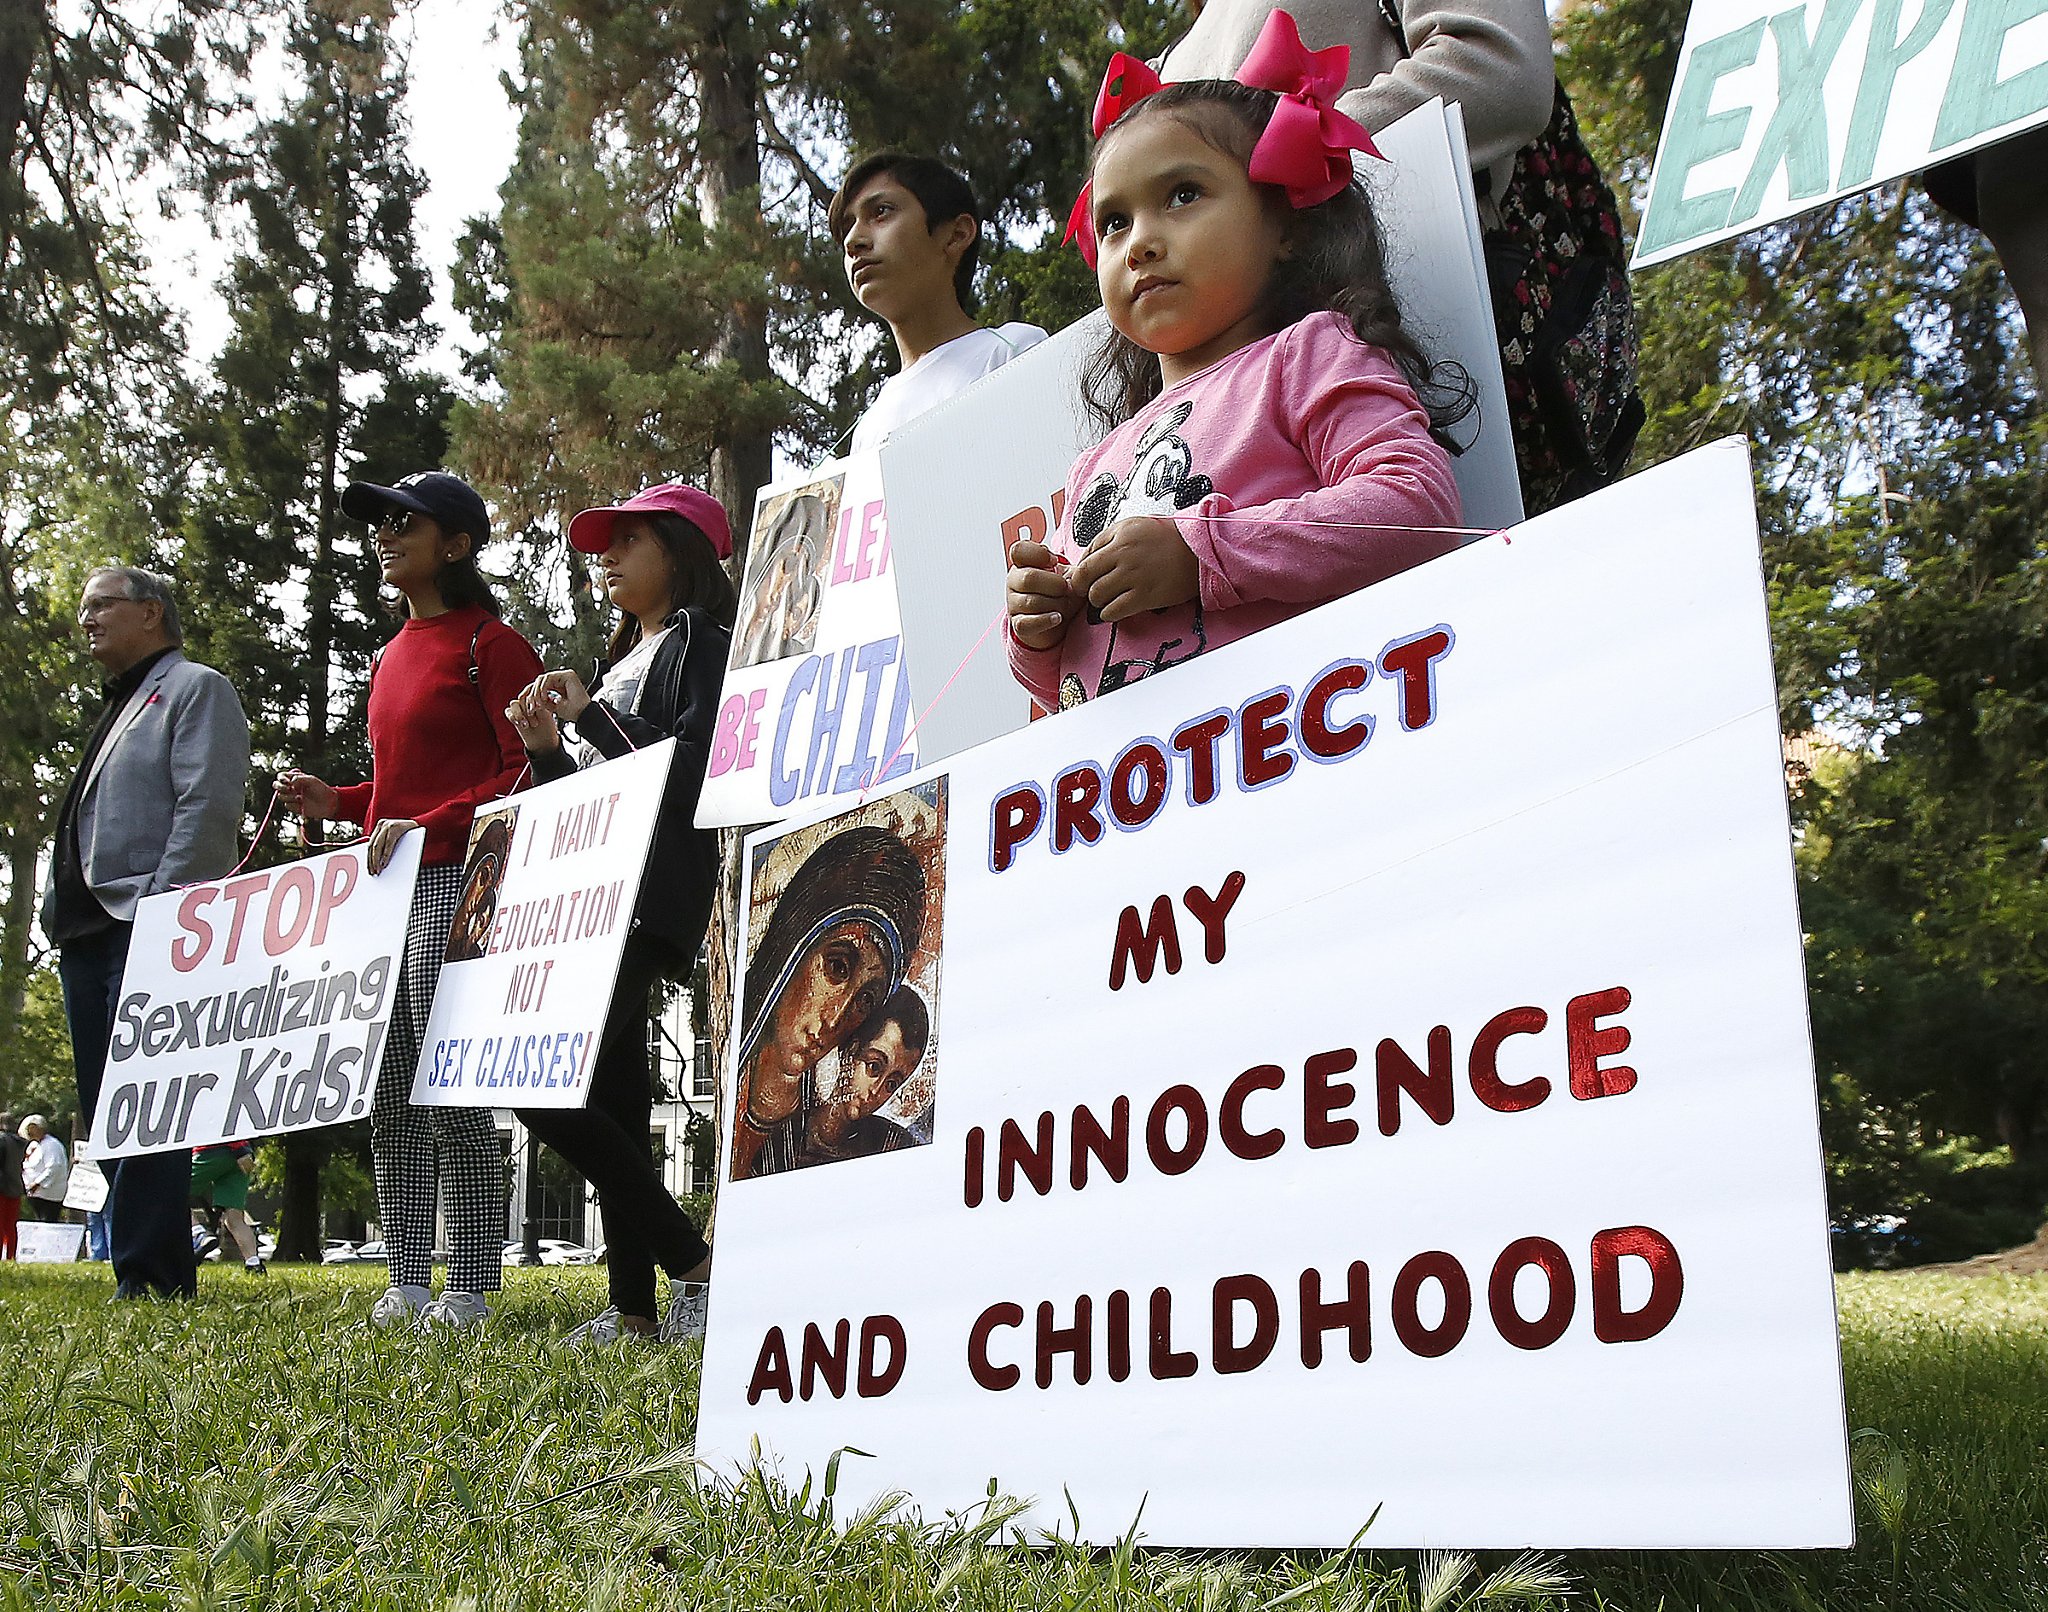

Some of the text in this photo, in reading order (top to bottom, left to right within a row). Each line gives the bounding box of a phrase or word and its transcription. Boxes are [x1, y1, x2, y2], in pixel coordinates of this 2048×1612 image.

[709, 634, 920, 807] BE CHIL
[988, 623, 1456, 874] PROTECT
[523, 793, 620, 867] I WANT
[171, 854, 359, 973] STOP
[488, 879, 624, 955] EDUCATION
[1109, 871, 1246, 991] MY
[111, 956, 391, 1062] Sexualizing
[503, 960, 554, 1015] NOT
[106, 1021, 386, 1149] our Kids!
[429, 1031, 593, 1088] SEX CLASSES!
[964, 986, 1638, 1208] INNOCENCE
[747, 1225, 1684, 1406] AND CHILDHOOD
